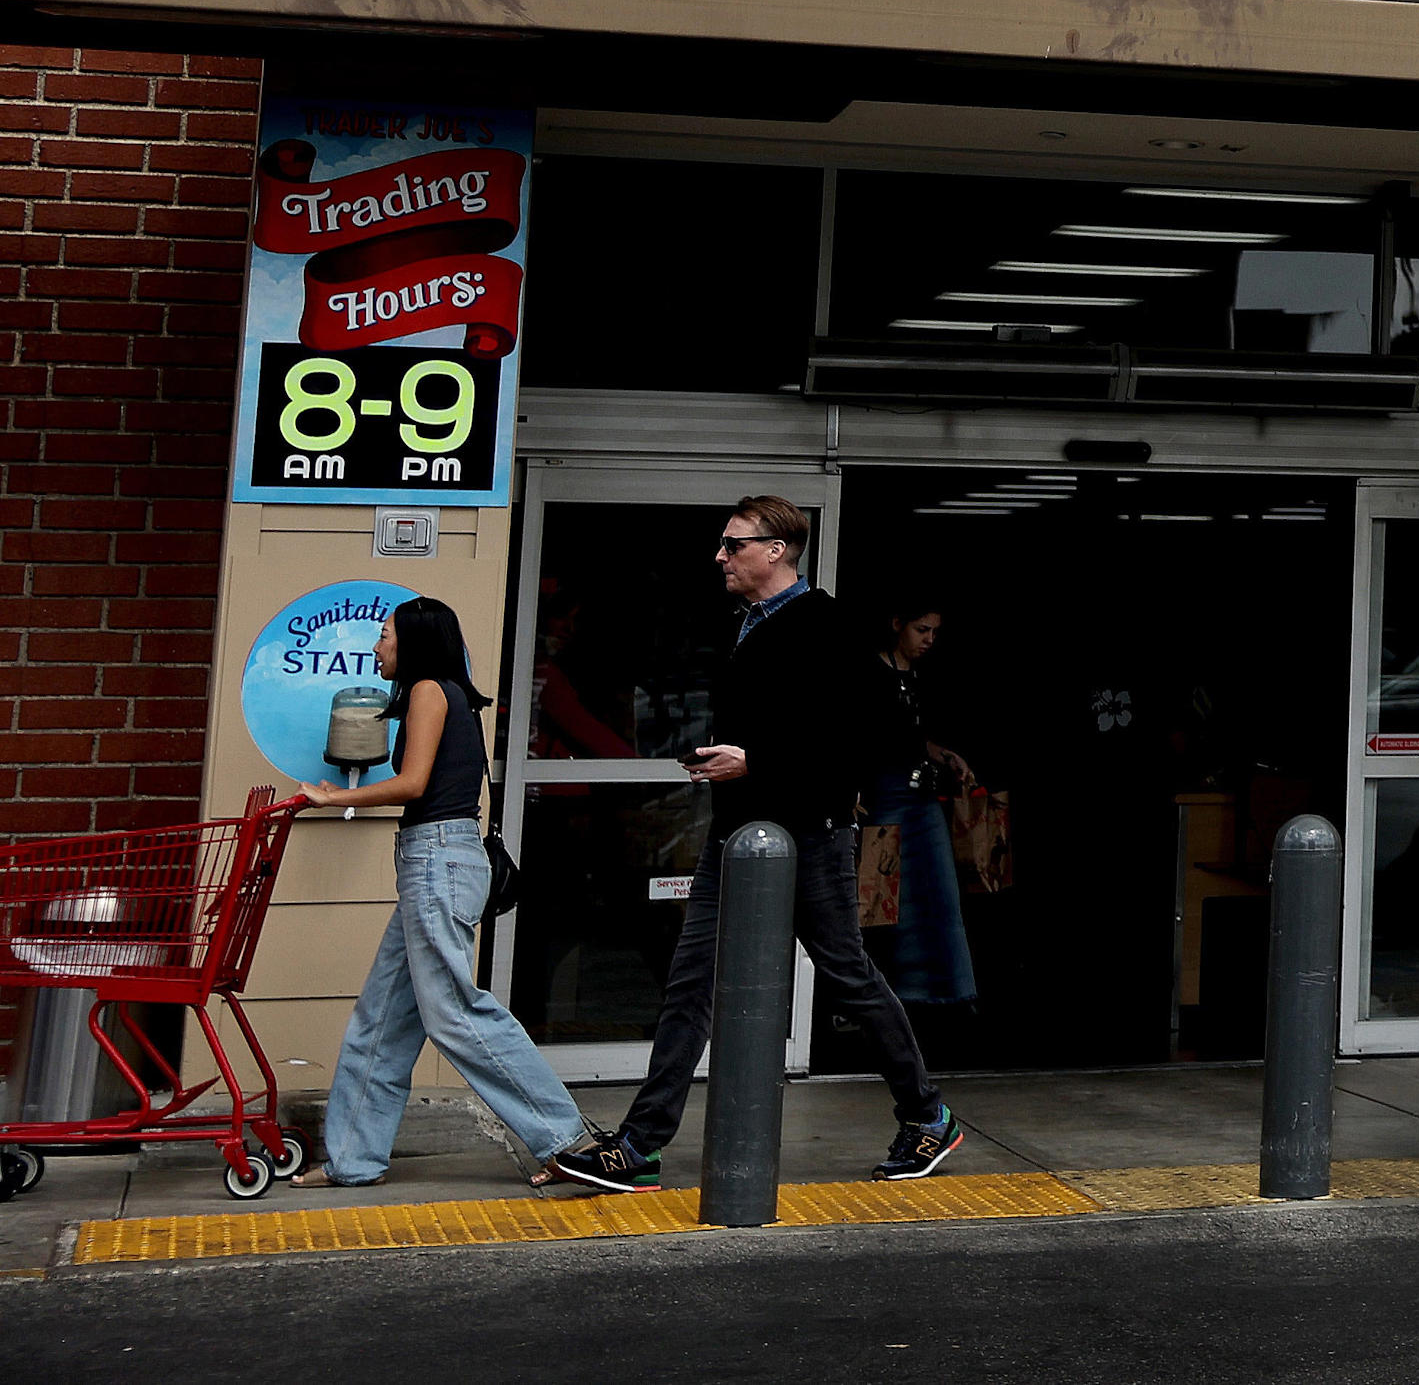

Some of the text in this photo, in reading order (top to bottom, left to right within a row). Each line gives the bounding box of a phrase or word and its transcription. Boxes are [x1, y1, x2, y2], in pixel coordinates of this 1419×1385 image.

[302, 109, 408, 140] TRADER
[281, 170, 491, 235] Trading
[328, 271, 486, 331] Hours:
[278, 356, 476, 454] 8-9
[283, 455, 462, 482] AM PM
[287, 595, 392, 648] Sanitati
